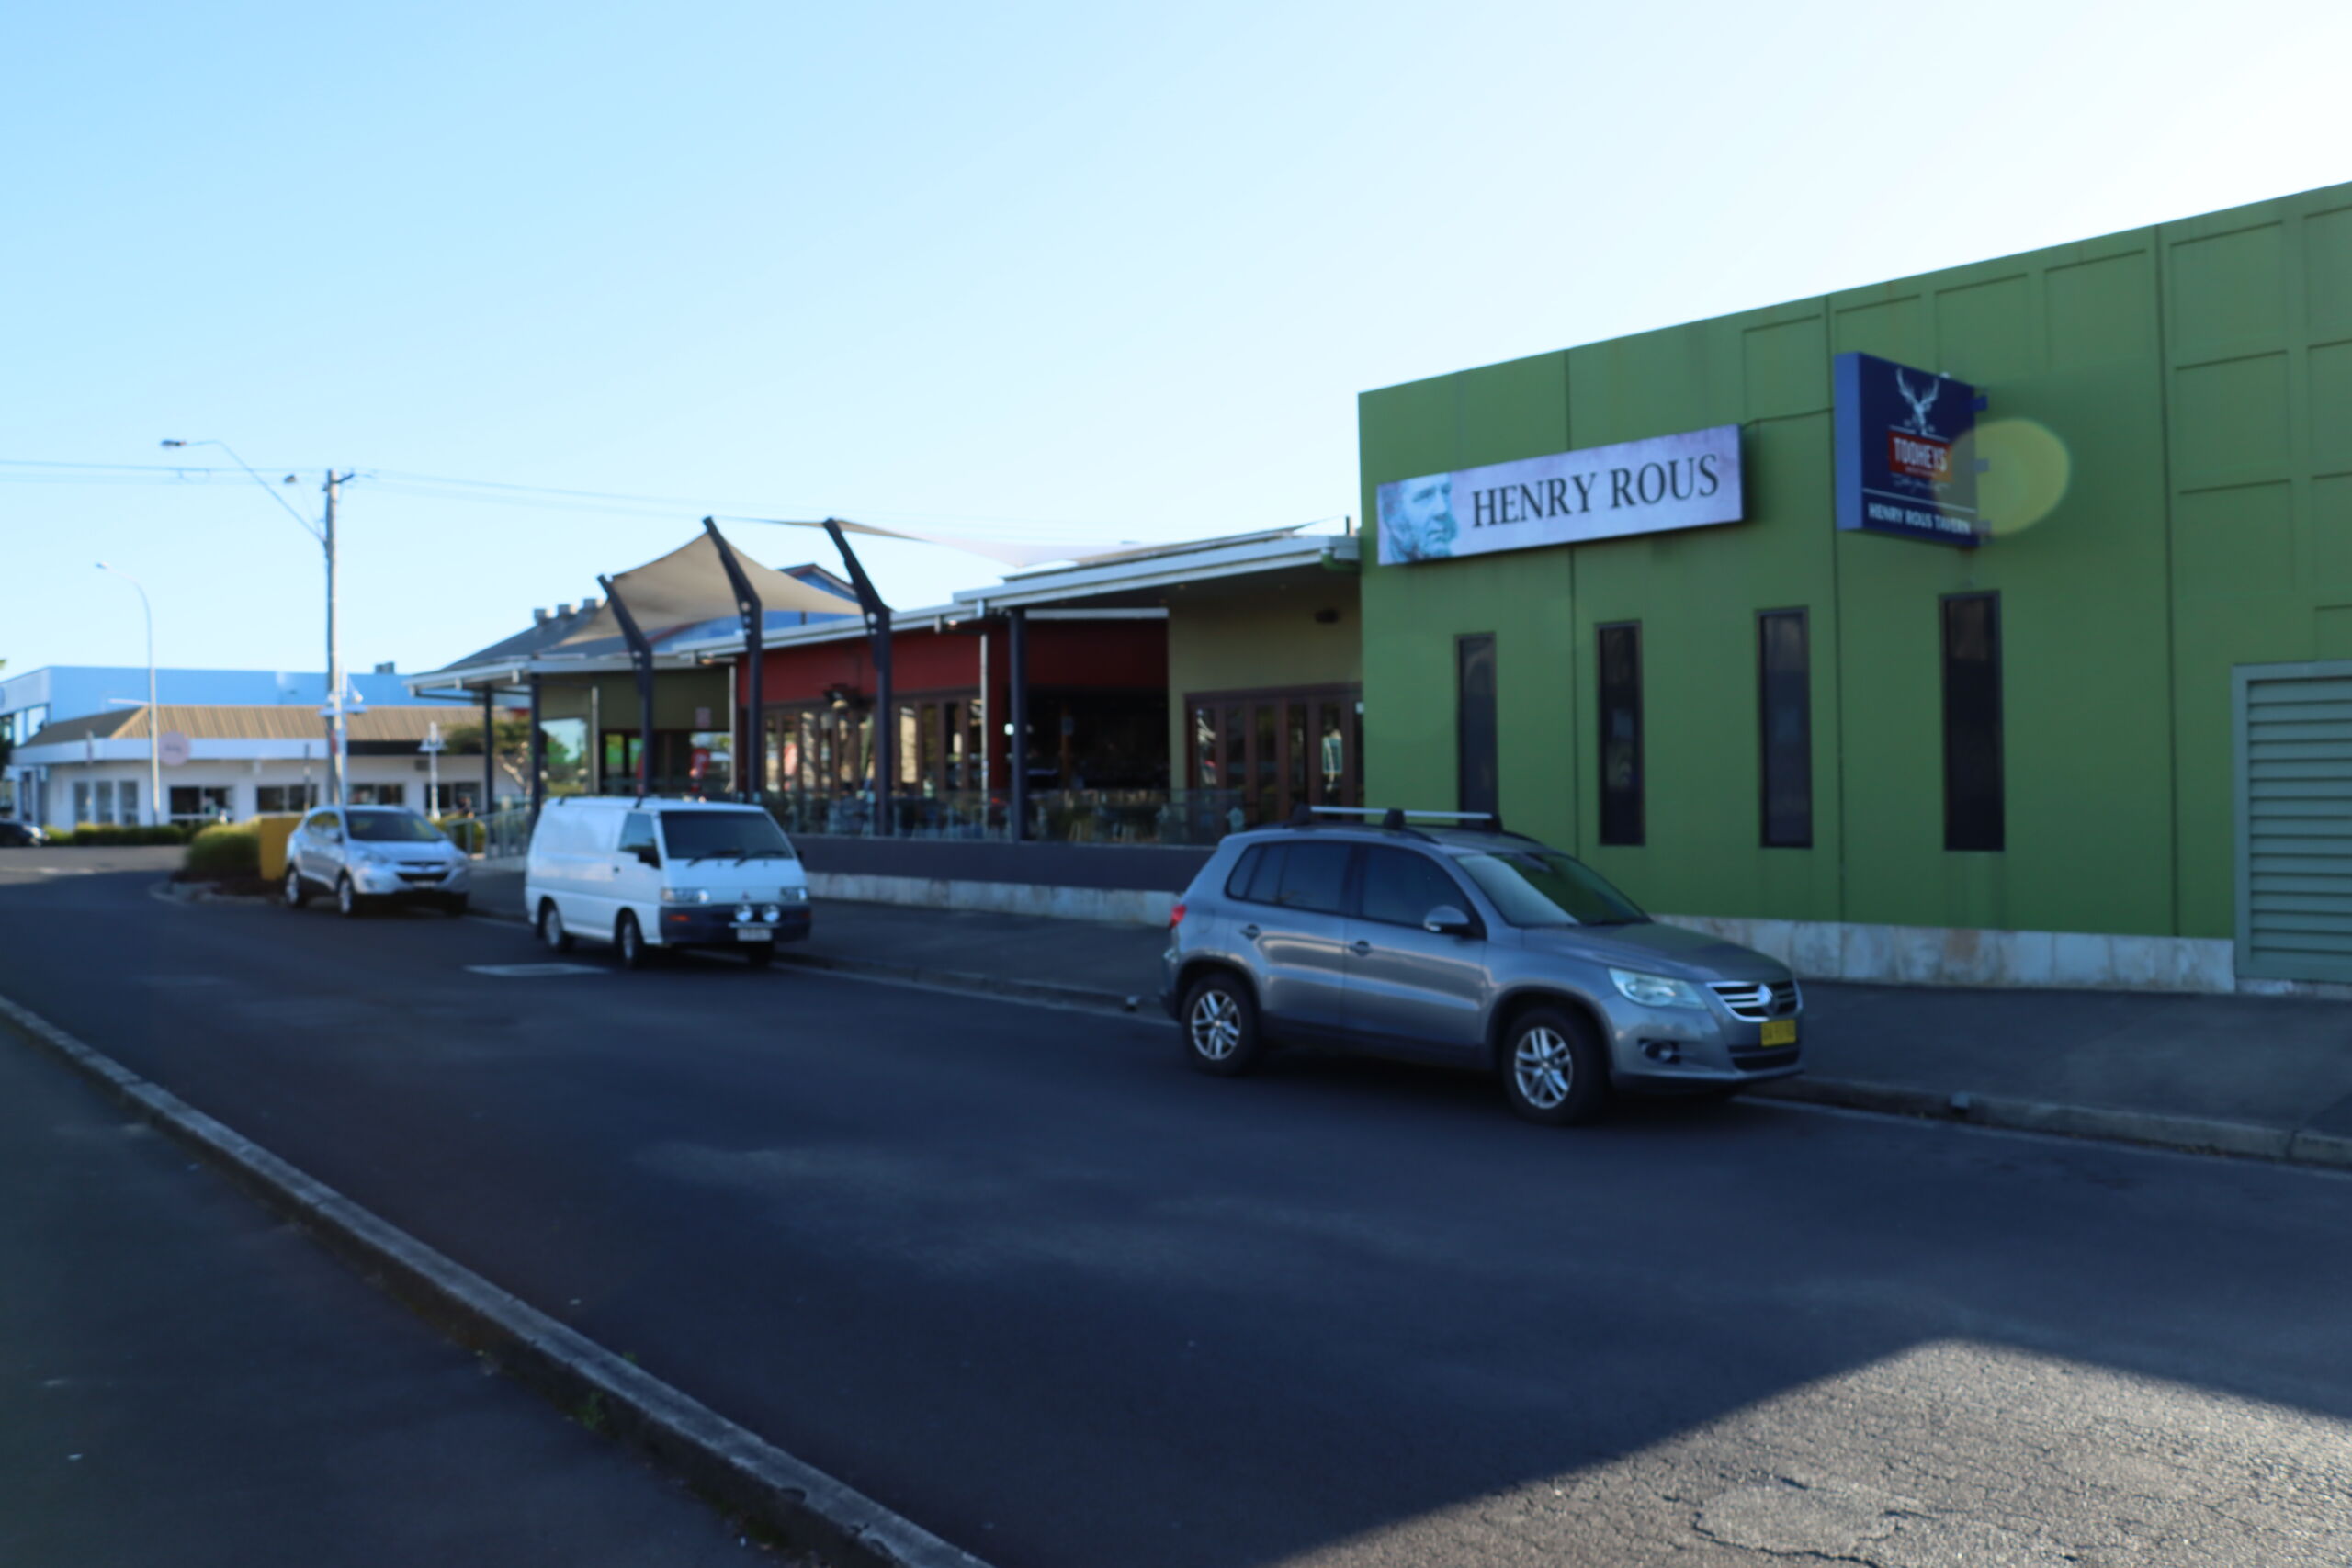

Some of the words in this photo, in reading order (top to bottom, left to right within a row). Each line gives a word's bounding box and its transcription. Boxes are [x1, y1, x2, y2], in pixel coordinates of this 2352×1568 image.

[1893, 437, 1948, 471] TOOHEYS
[1472, 471, 1597, 527] HENRY
[1611, 454, 1719, 509] ROUS
[1868, 502, 1903, 524] HENRY
[1905, 509, 1932, 529] ROUS
[1934, 514, 1972, 535] TAVERN
